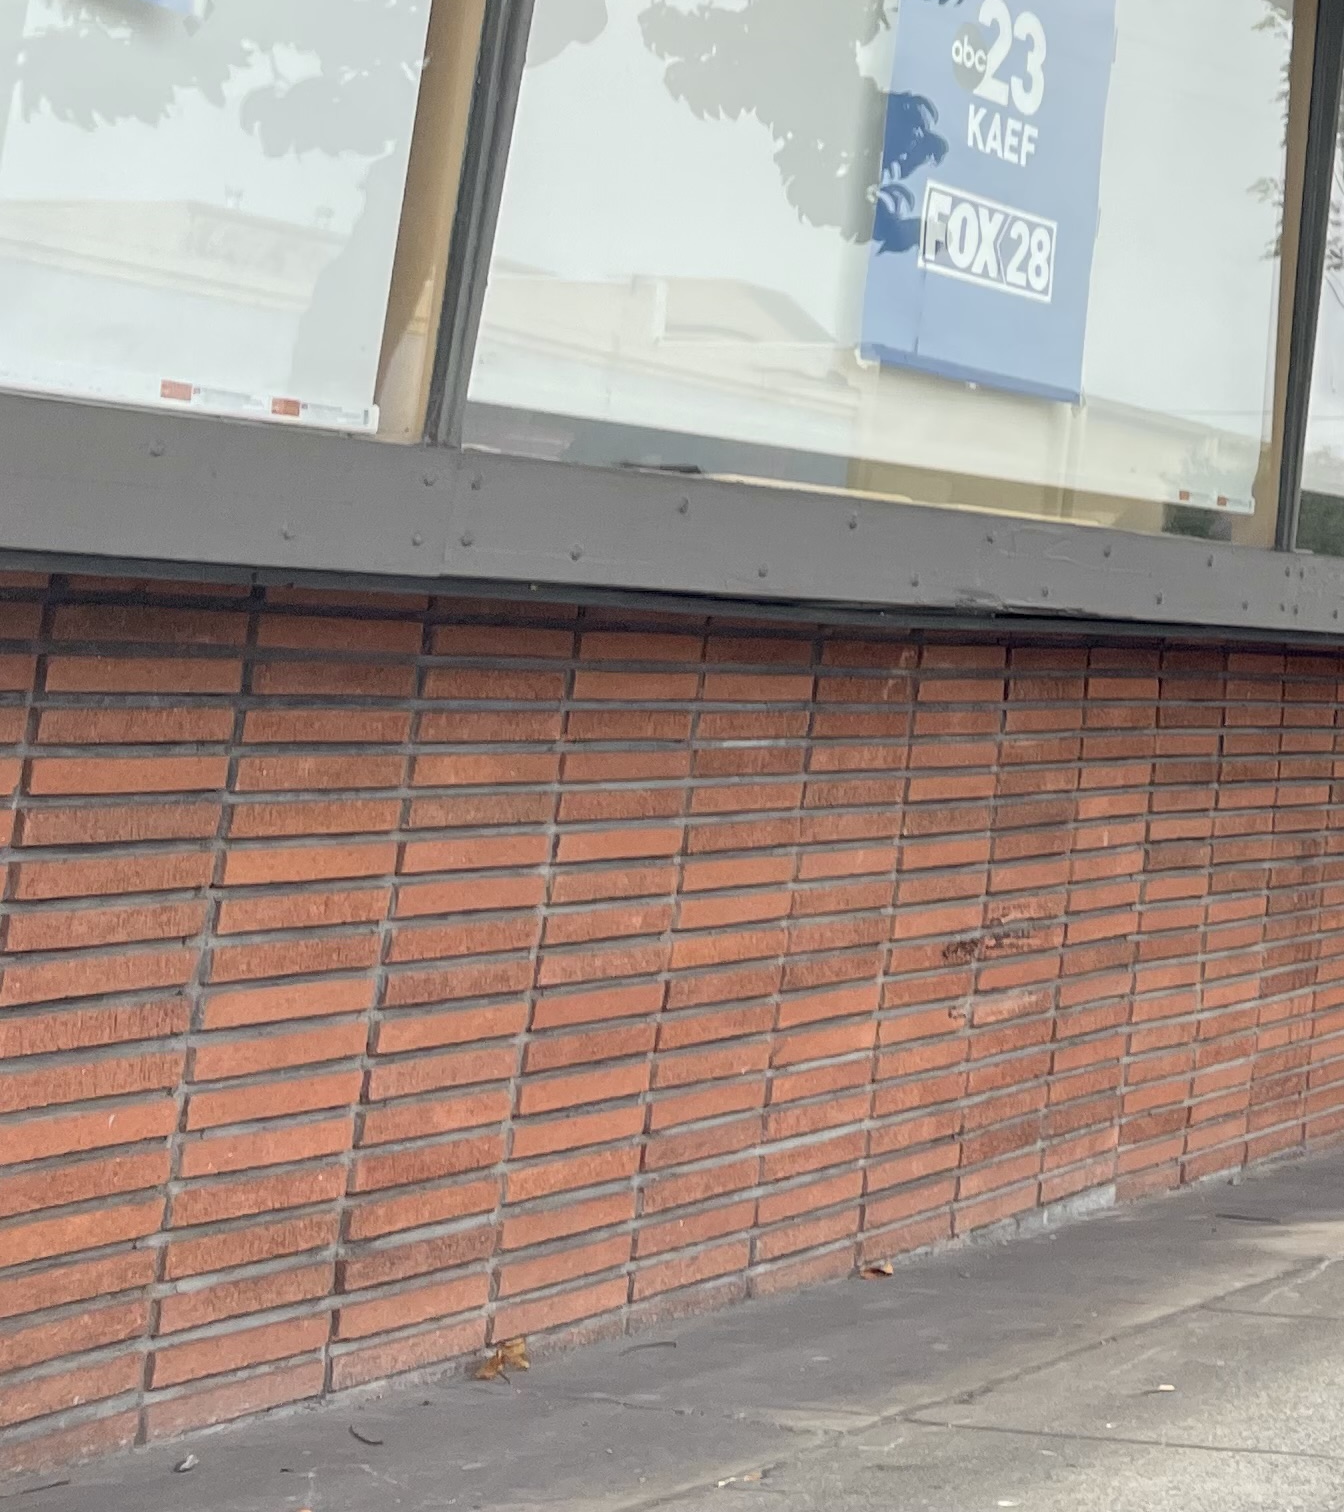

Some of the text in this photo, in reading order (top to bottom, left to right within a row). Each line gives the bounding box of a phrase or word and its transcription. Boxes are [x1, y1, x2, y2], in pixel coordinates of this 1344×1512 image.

[951, 34, 987, 71] abc
[967, 102, 1039, 168] KAEF
[924, 191, 1051, 292] FOX 28
